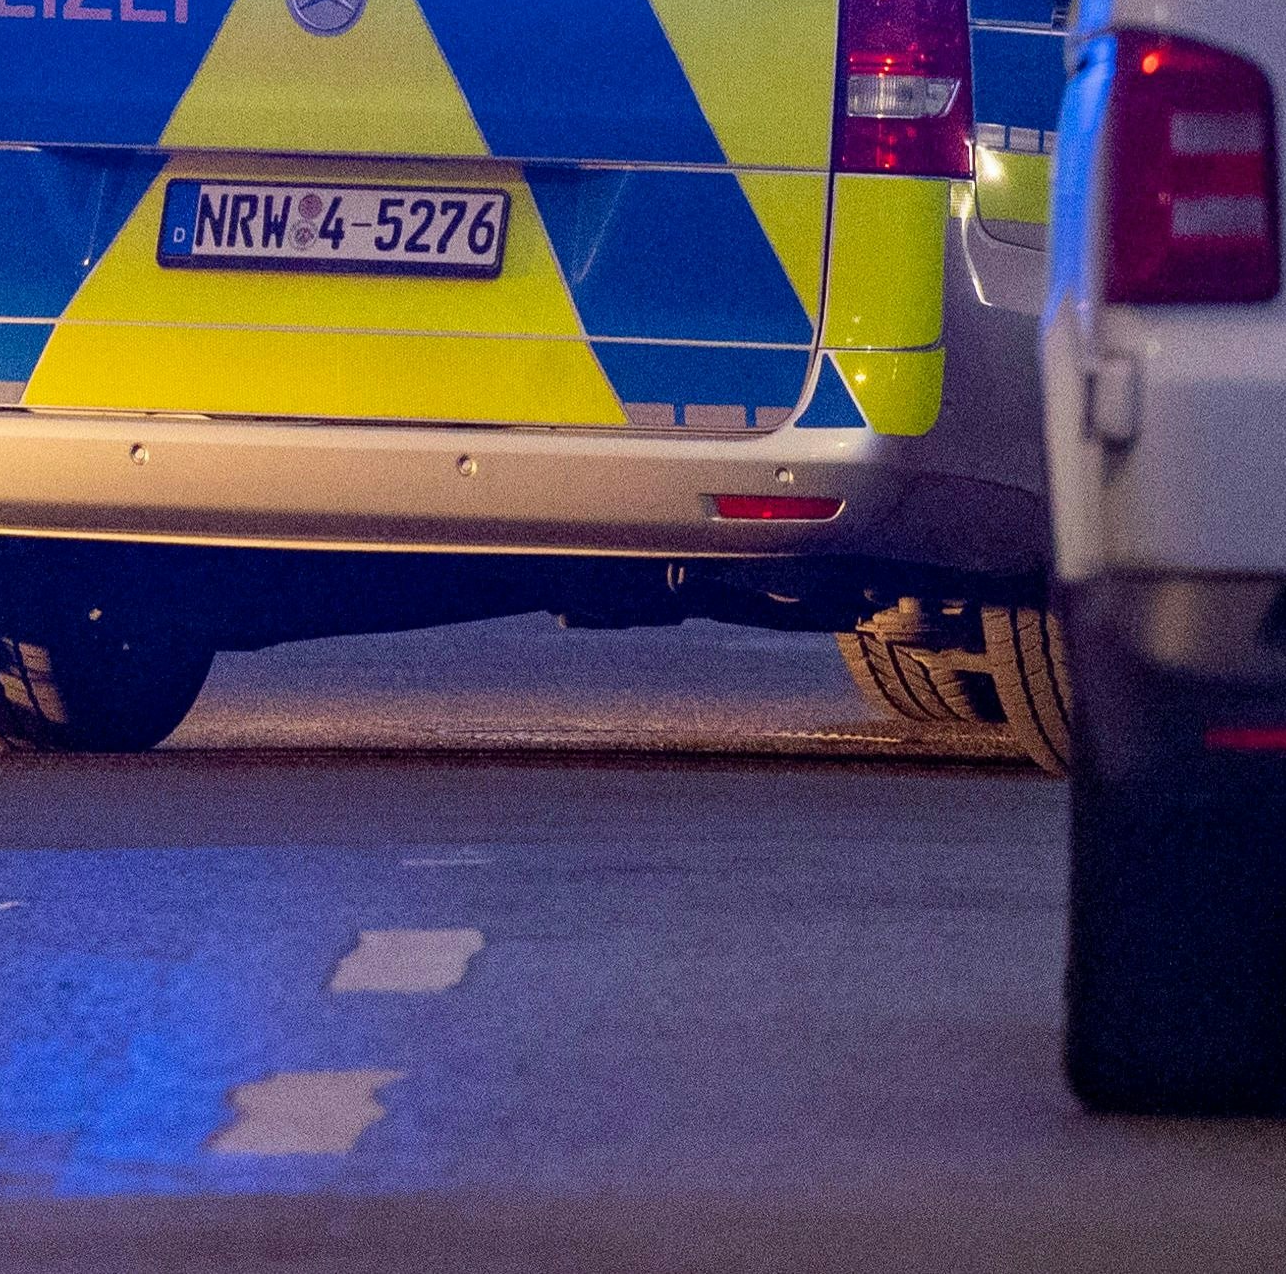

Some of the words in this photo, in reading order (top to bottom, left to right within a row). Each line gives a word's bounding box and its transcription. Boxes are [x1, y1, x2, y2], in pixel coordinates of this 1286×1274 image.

[173, 227, 186, 243] D
[194, 193, 292, 249] NRW
[318, 195, 496, 255] 4-5276
